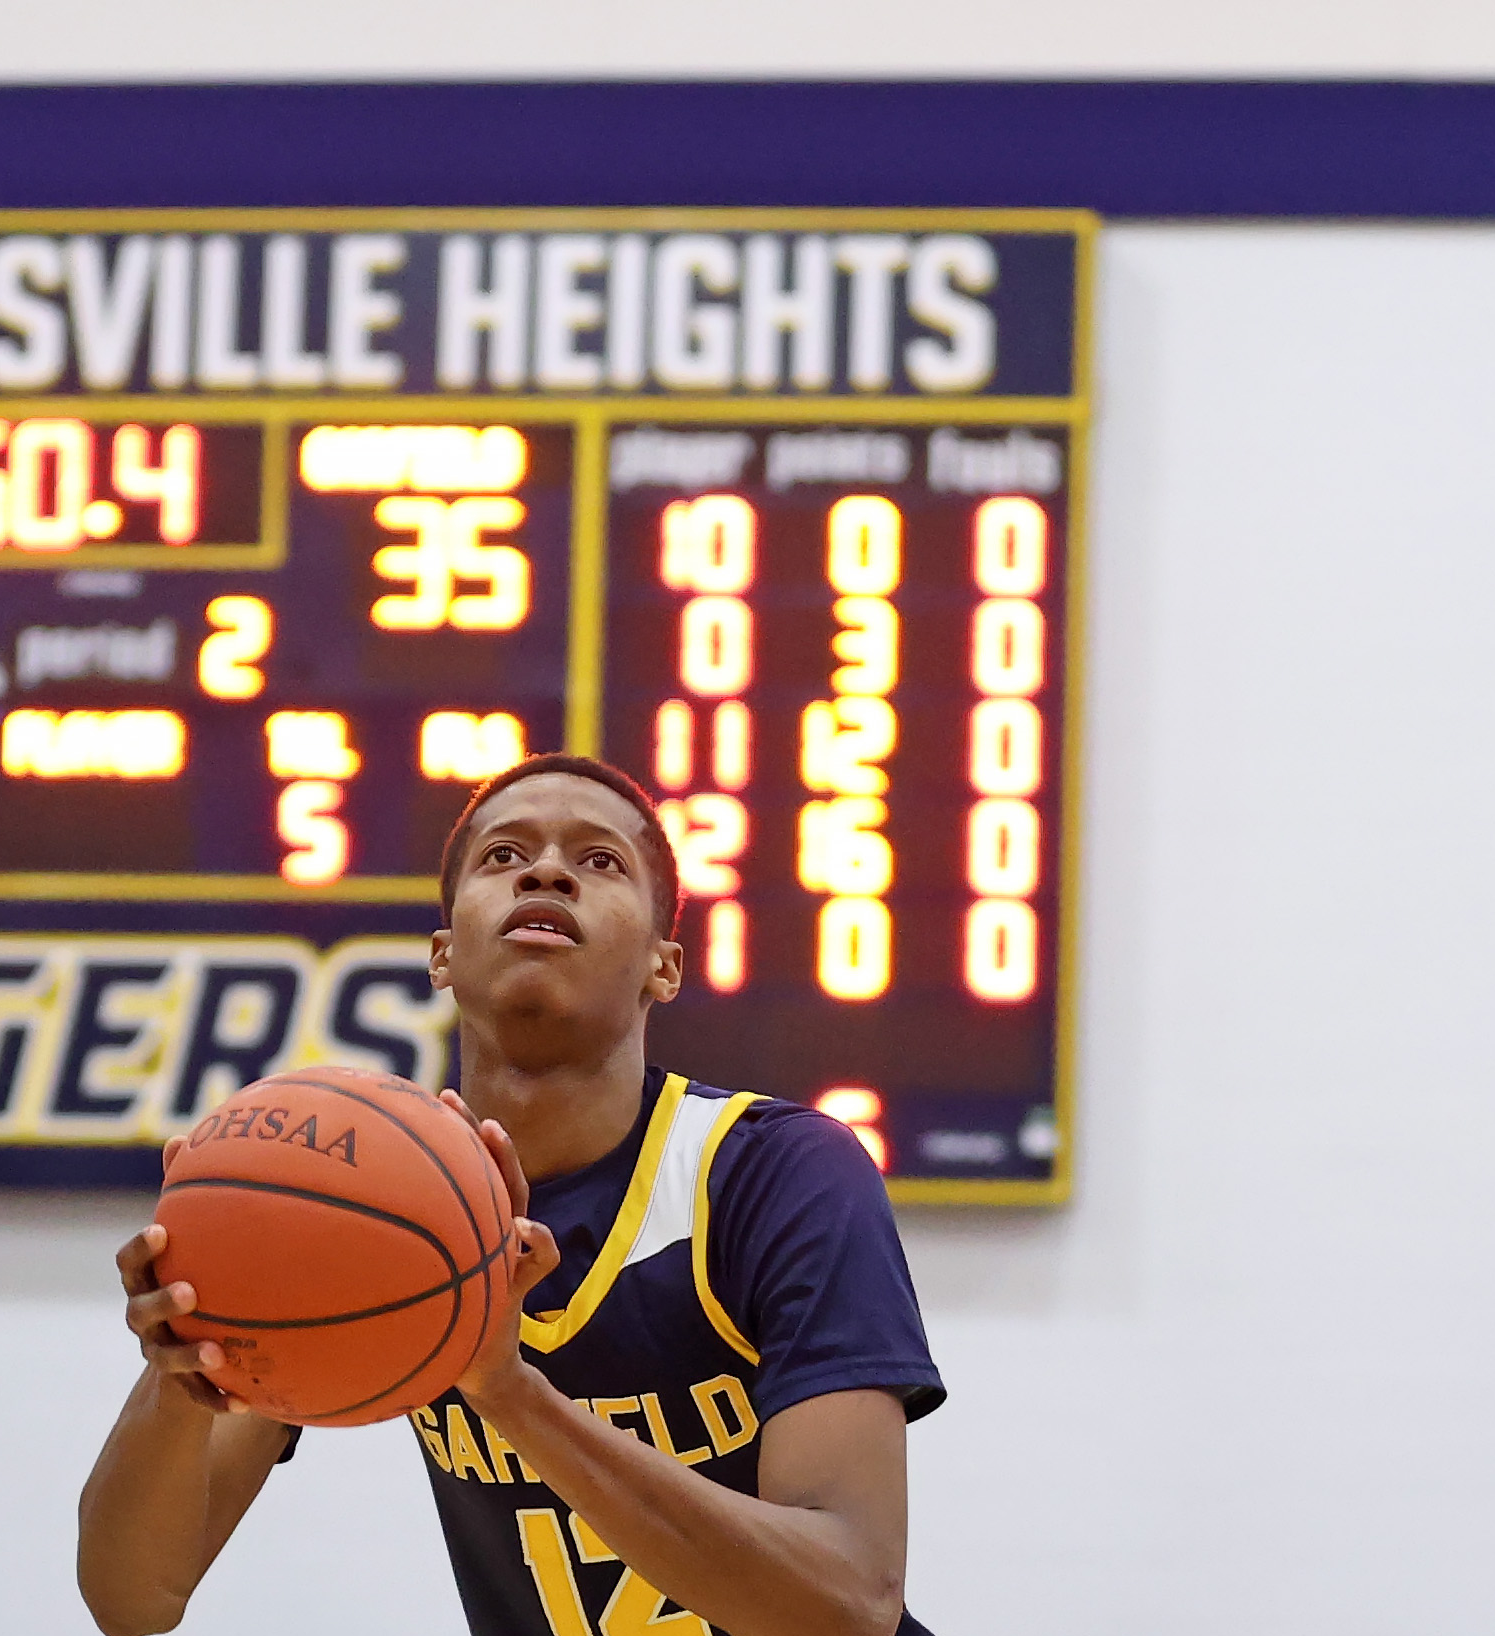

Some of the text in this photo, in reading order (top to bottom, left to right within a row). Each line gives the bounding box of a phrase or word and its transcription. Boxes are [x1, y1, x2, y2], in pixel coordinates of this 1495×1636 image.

[435, 233, 998, 392] HEIGHTS
[370, 495, 532, 632] 35
[660, 494, 1047, 596] 10 0 0
[198, 596, 273, 699] 2
[679, 596, 1044, 697] 0 3 0
[655, 698, 751, 791] 11
[970, 697, 1043, 796] 0
[276, 780, 350, 886] 5
[968, 797, 1040, 896] 0
[816, 896, 890, 999] 0
[965, 896, 1039, 1001] 0
[189, 1107, 358, 1167] OHSAA
